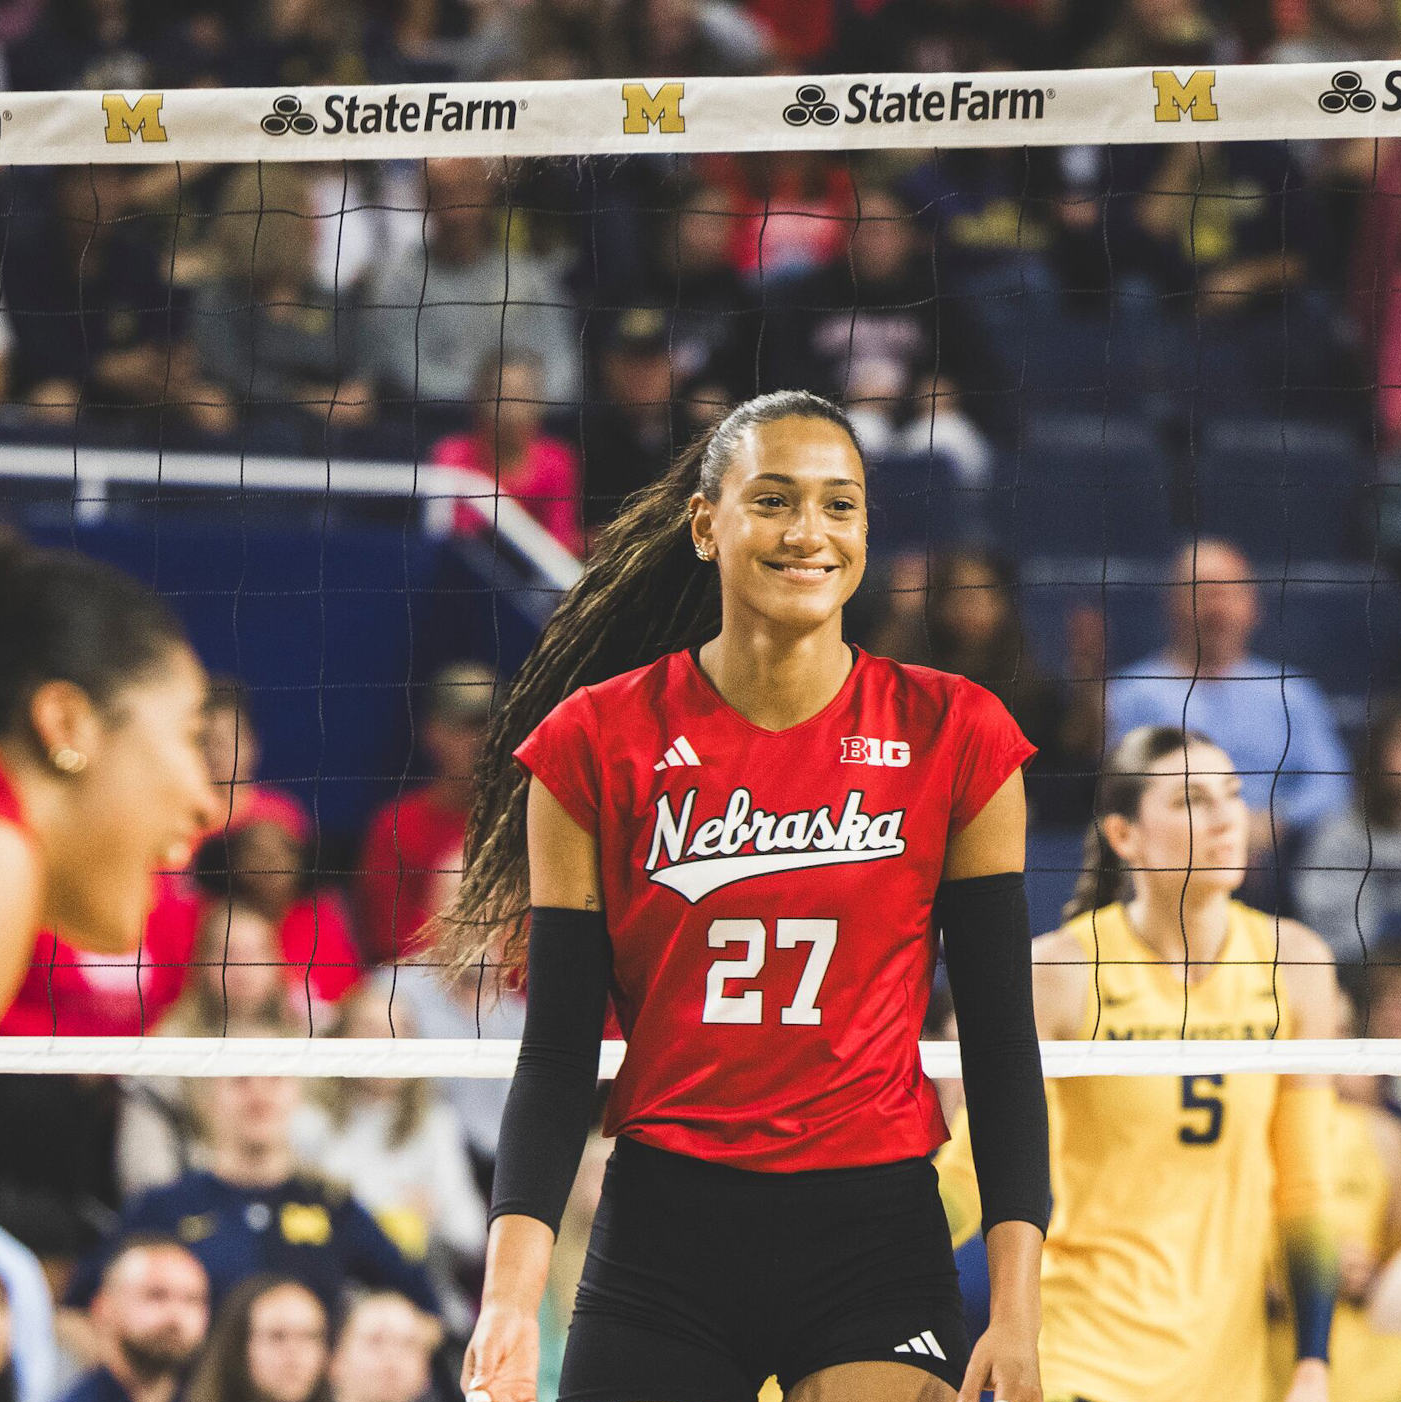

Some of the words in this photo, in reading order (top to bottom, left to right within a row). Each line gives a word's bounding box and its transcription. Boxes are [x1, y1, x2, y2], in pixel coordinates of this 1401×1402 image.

[102, 93, 167, 143] M
[622, 82, 685, 134] M
[1152, 70, 1218, 122] M
[644, 787, 907, 870] Nebraska
[702, 917, 839, 1025] 27
[1175, 1073, 1226, 1145] 5
